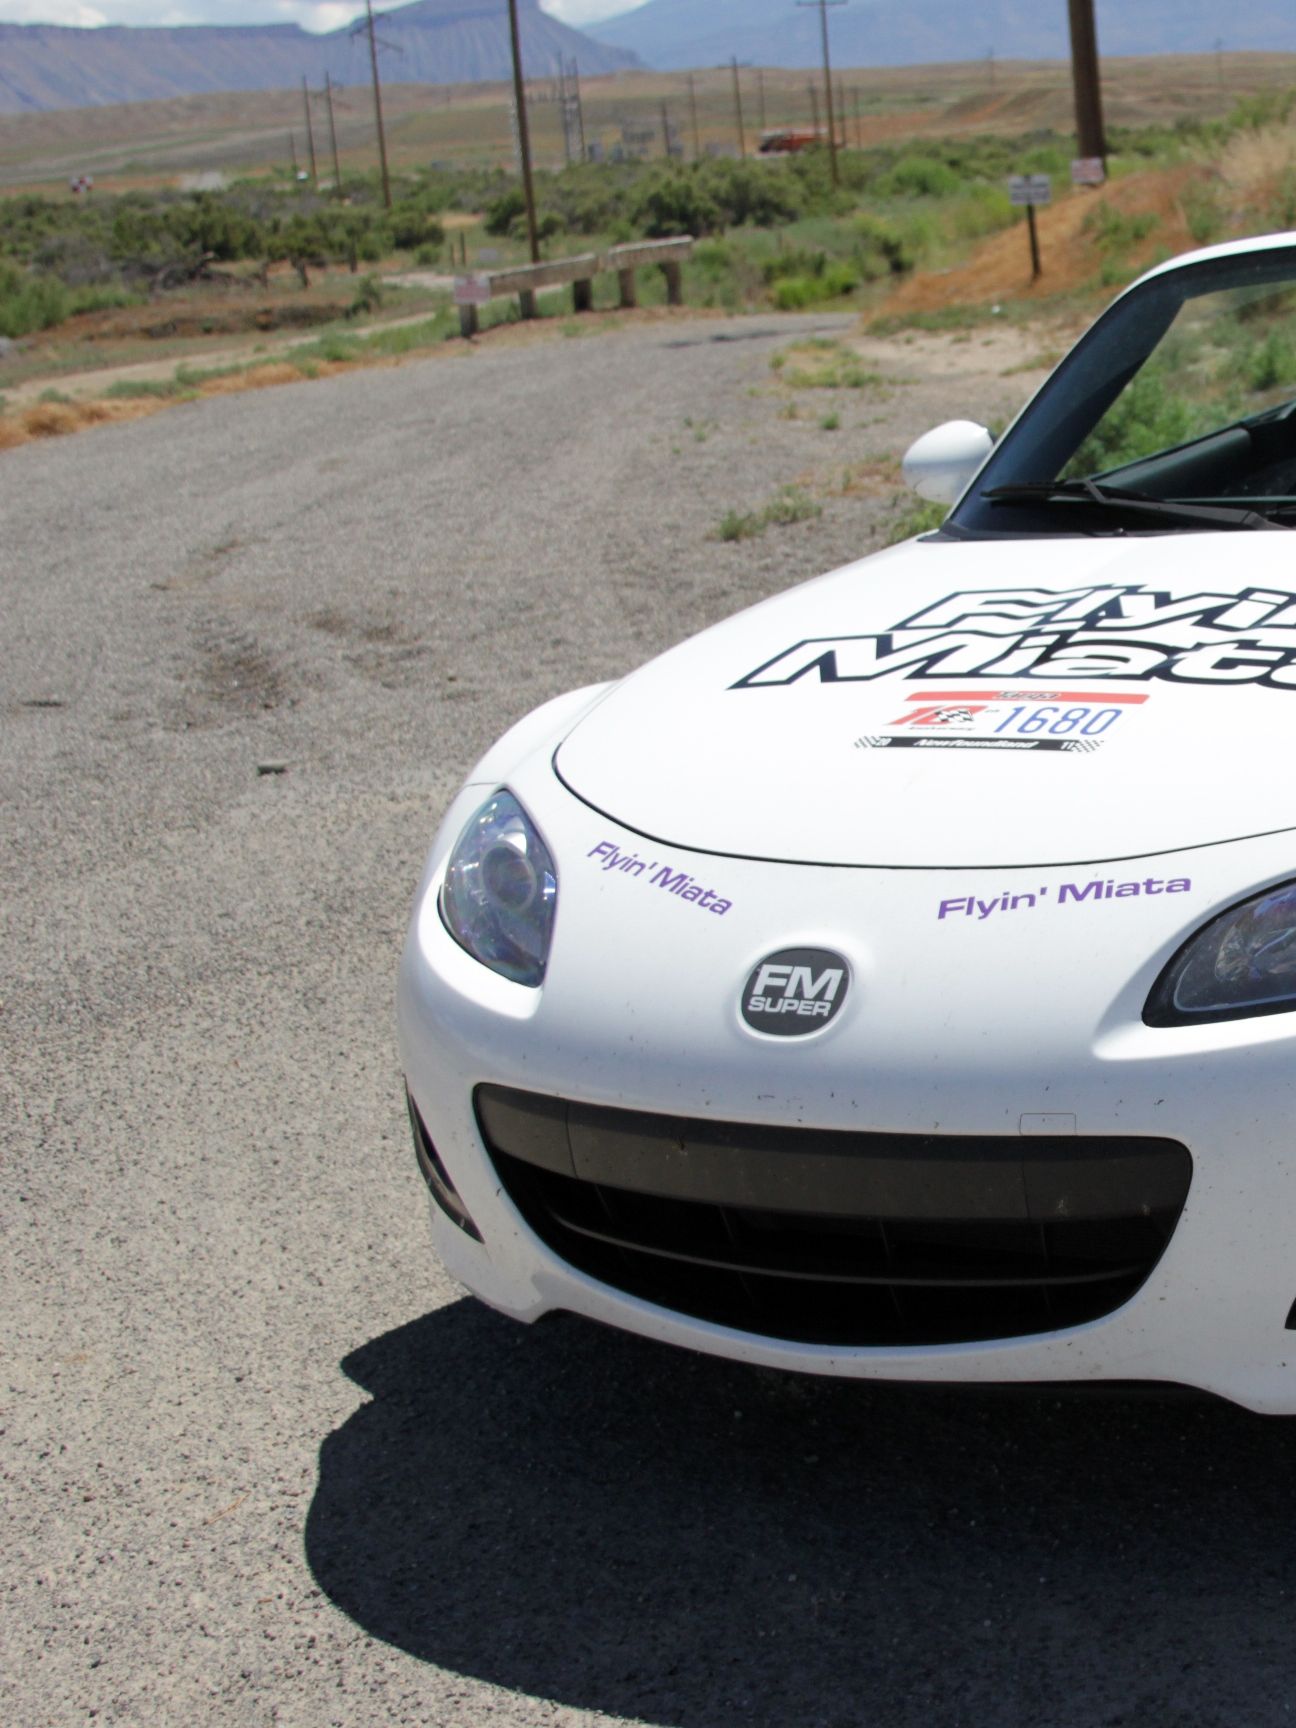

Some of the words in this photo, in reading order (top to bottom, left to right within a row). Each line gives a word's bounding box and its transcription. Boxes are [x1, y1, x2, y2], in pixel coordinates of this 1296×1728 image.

[994, 705, 1123, 735] 1680
[587, 841, 654, 876] Flyin'
[649, 866, 732, 916] Miata
[937, 885, 1047, 919] Flyin'
[1056, 875, 1191, 904] Miata
[751, 963, 844, 1000] FM
[748, 996, 831, 1017] SUPER
